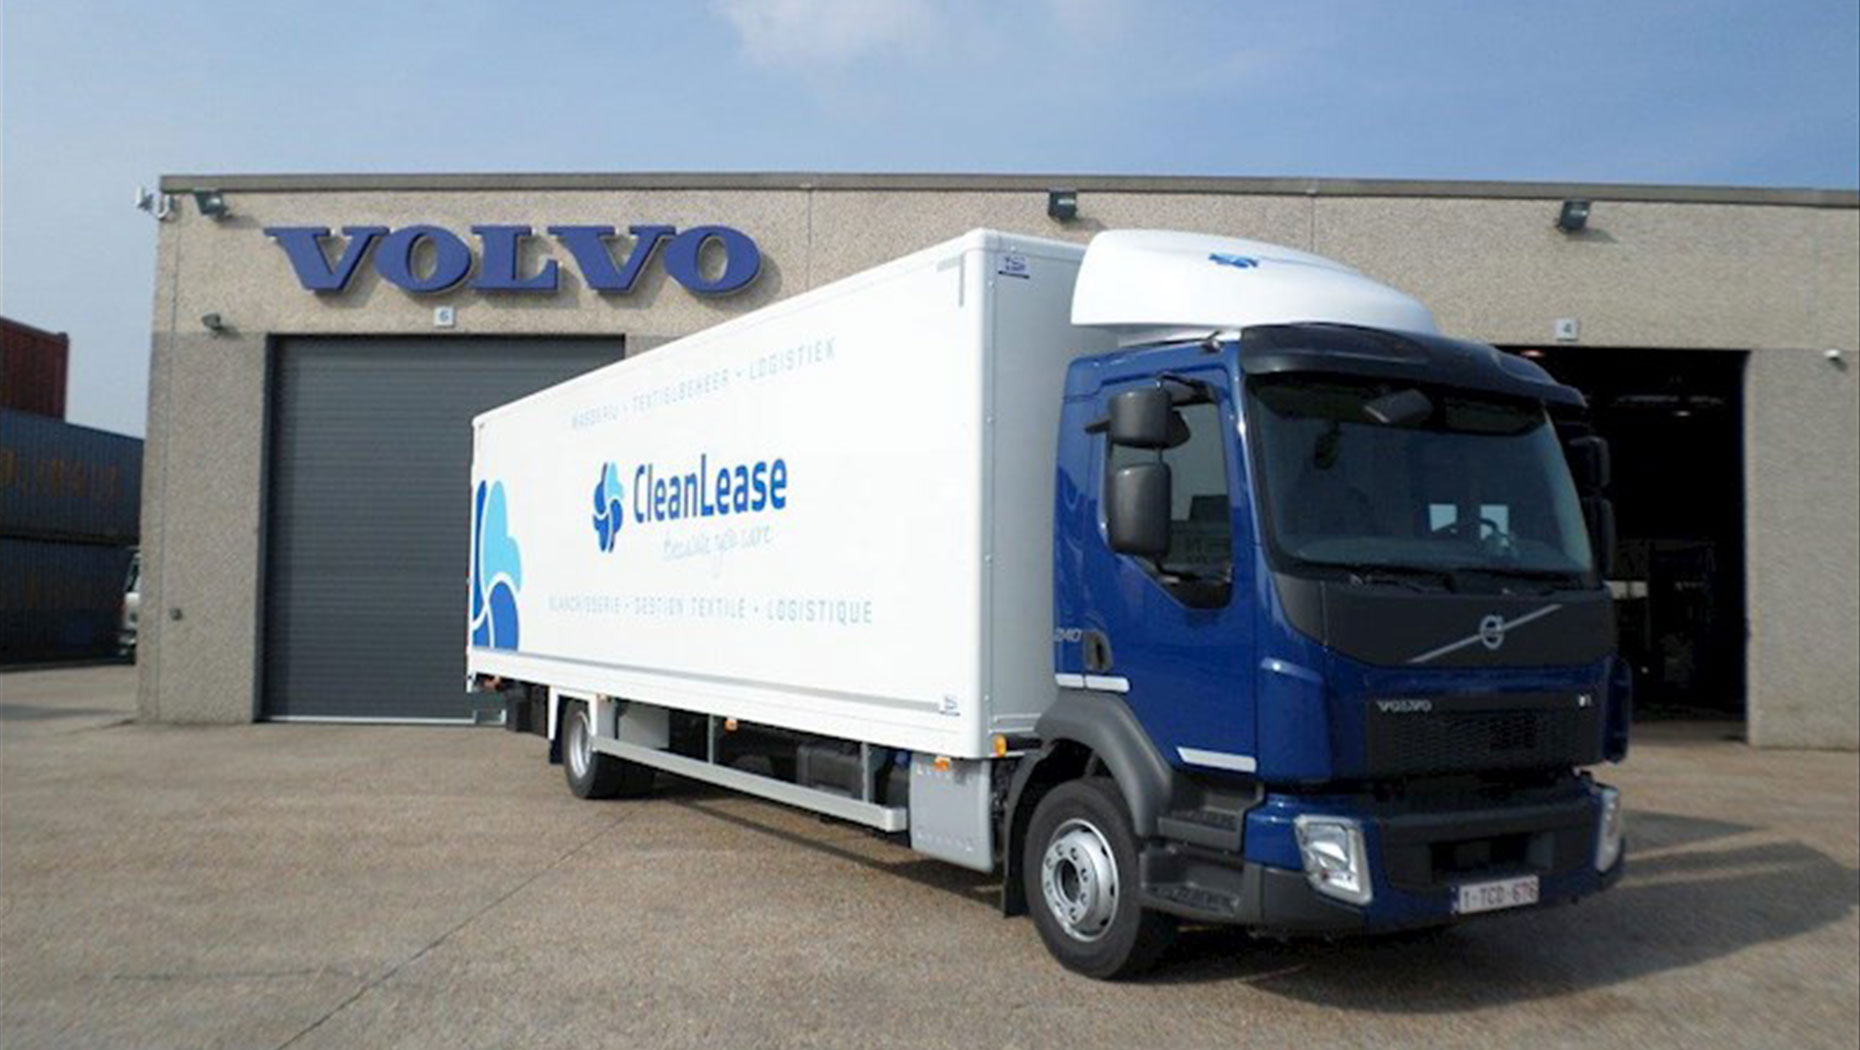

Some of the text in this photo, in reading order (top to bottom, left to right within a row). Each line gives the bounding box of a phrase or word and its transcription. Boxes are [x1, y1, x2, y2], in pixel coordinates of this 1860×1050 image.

[265, 223, 762, 295] VOLVO
[749, 336, 837, 380] LOGISTIEK
[632, 452, 788, 523] CleanLease
[690, 596, 746, 619] TEXTILE
[767, 599, 873, 627] LOGISTIQUE
[1376, 699, 1432, 712] VOLVO
